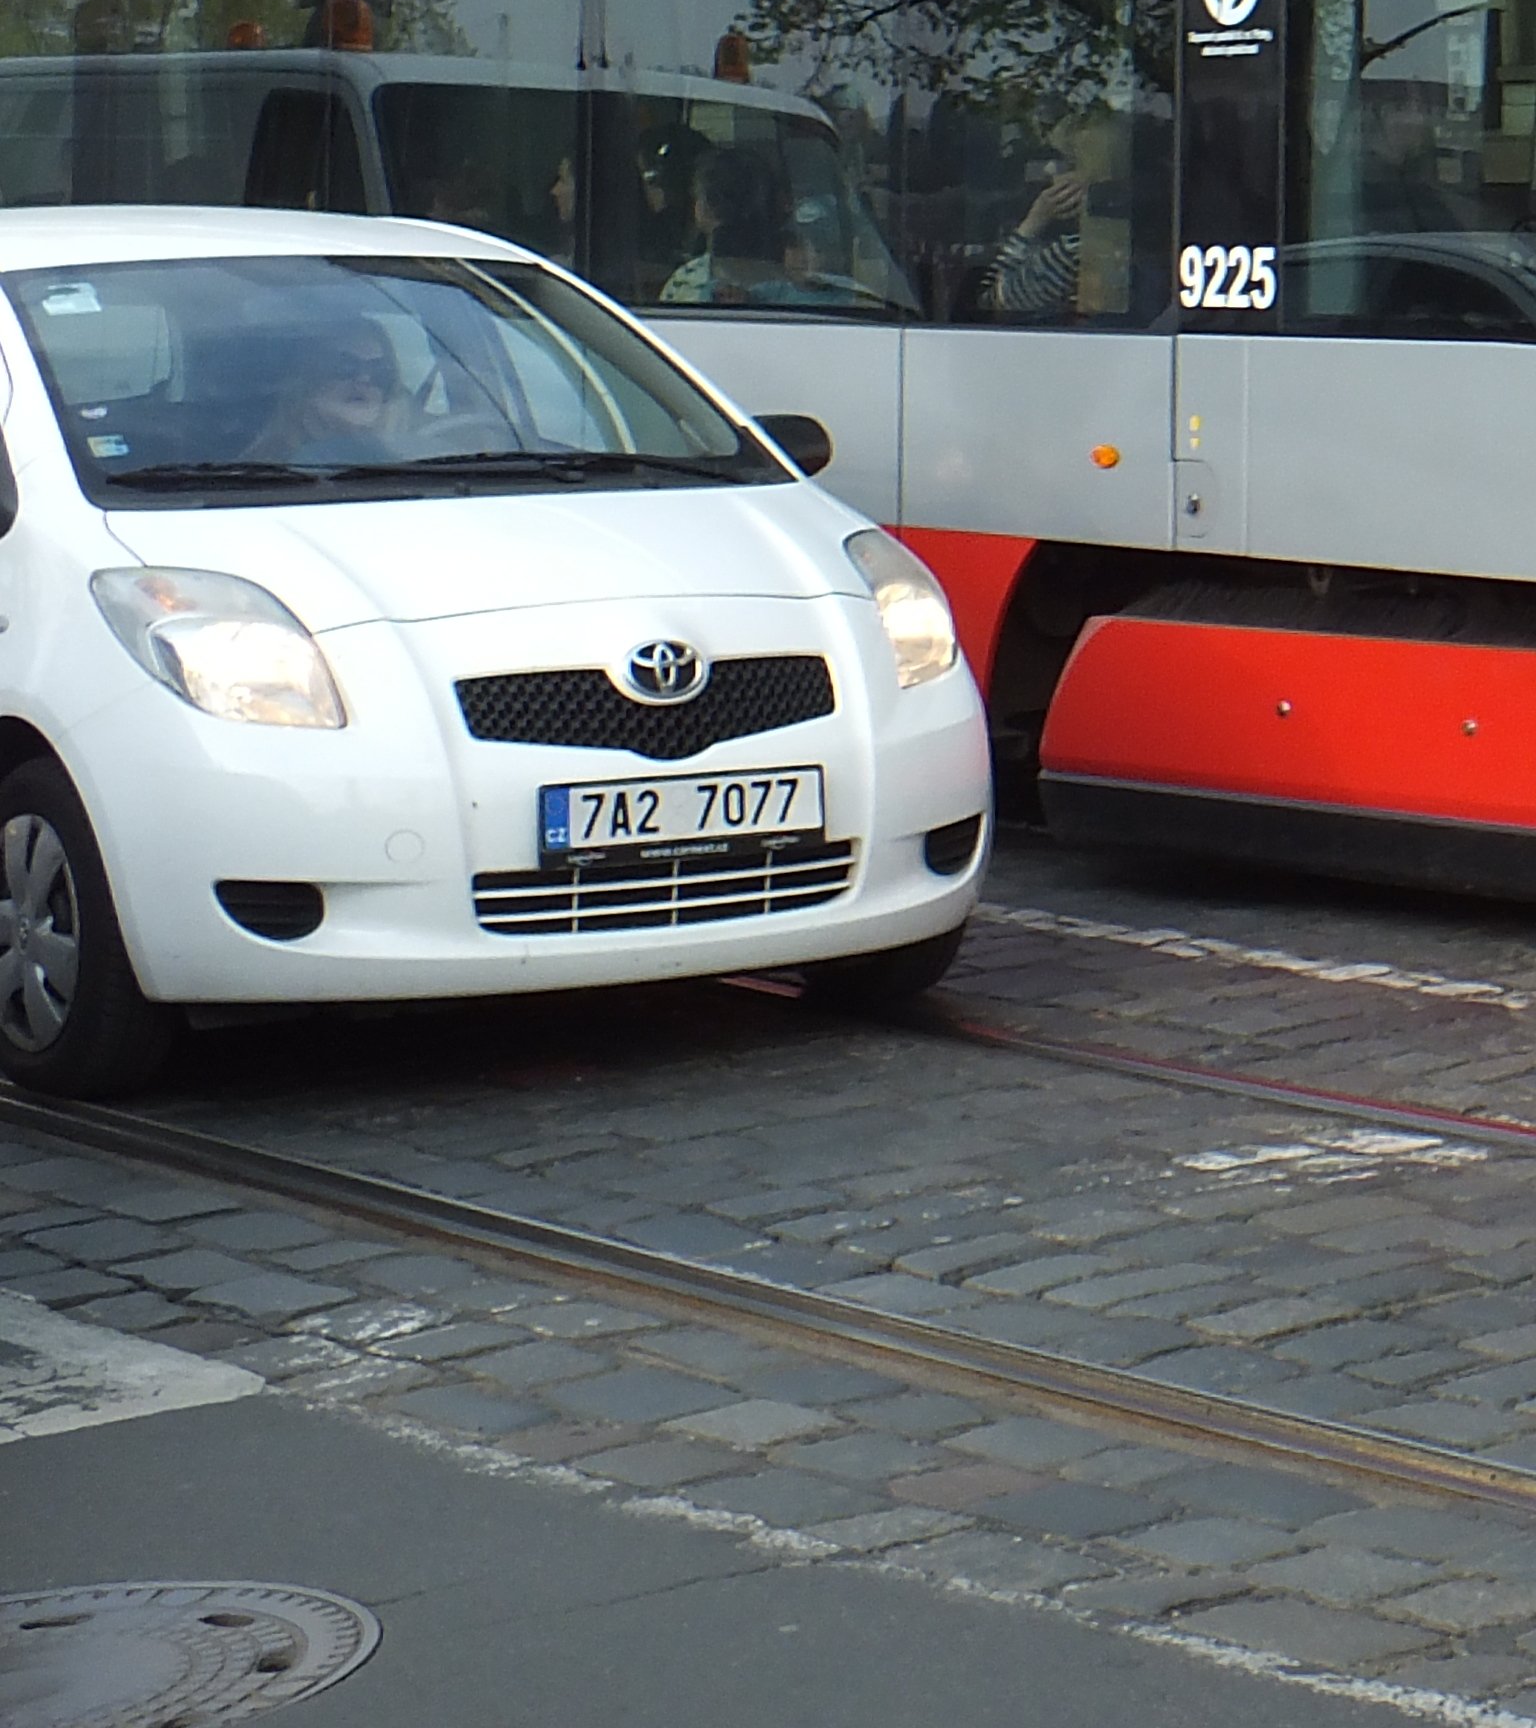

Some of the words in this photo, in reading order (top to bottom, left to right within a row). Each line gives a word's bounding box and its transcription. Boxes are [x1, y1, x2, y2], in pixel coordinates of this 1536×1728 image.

[1178, 244, 1279, 311] 9225
[546, 828, 568, 844] CZ
[581, 789, 661, 840] 7A2
[696, 777, 800, 832] 7077
